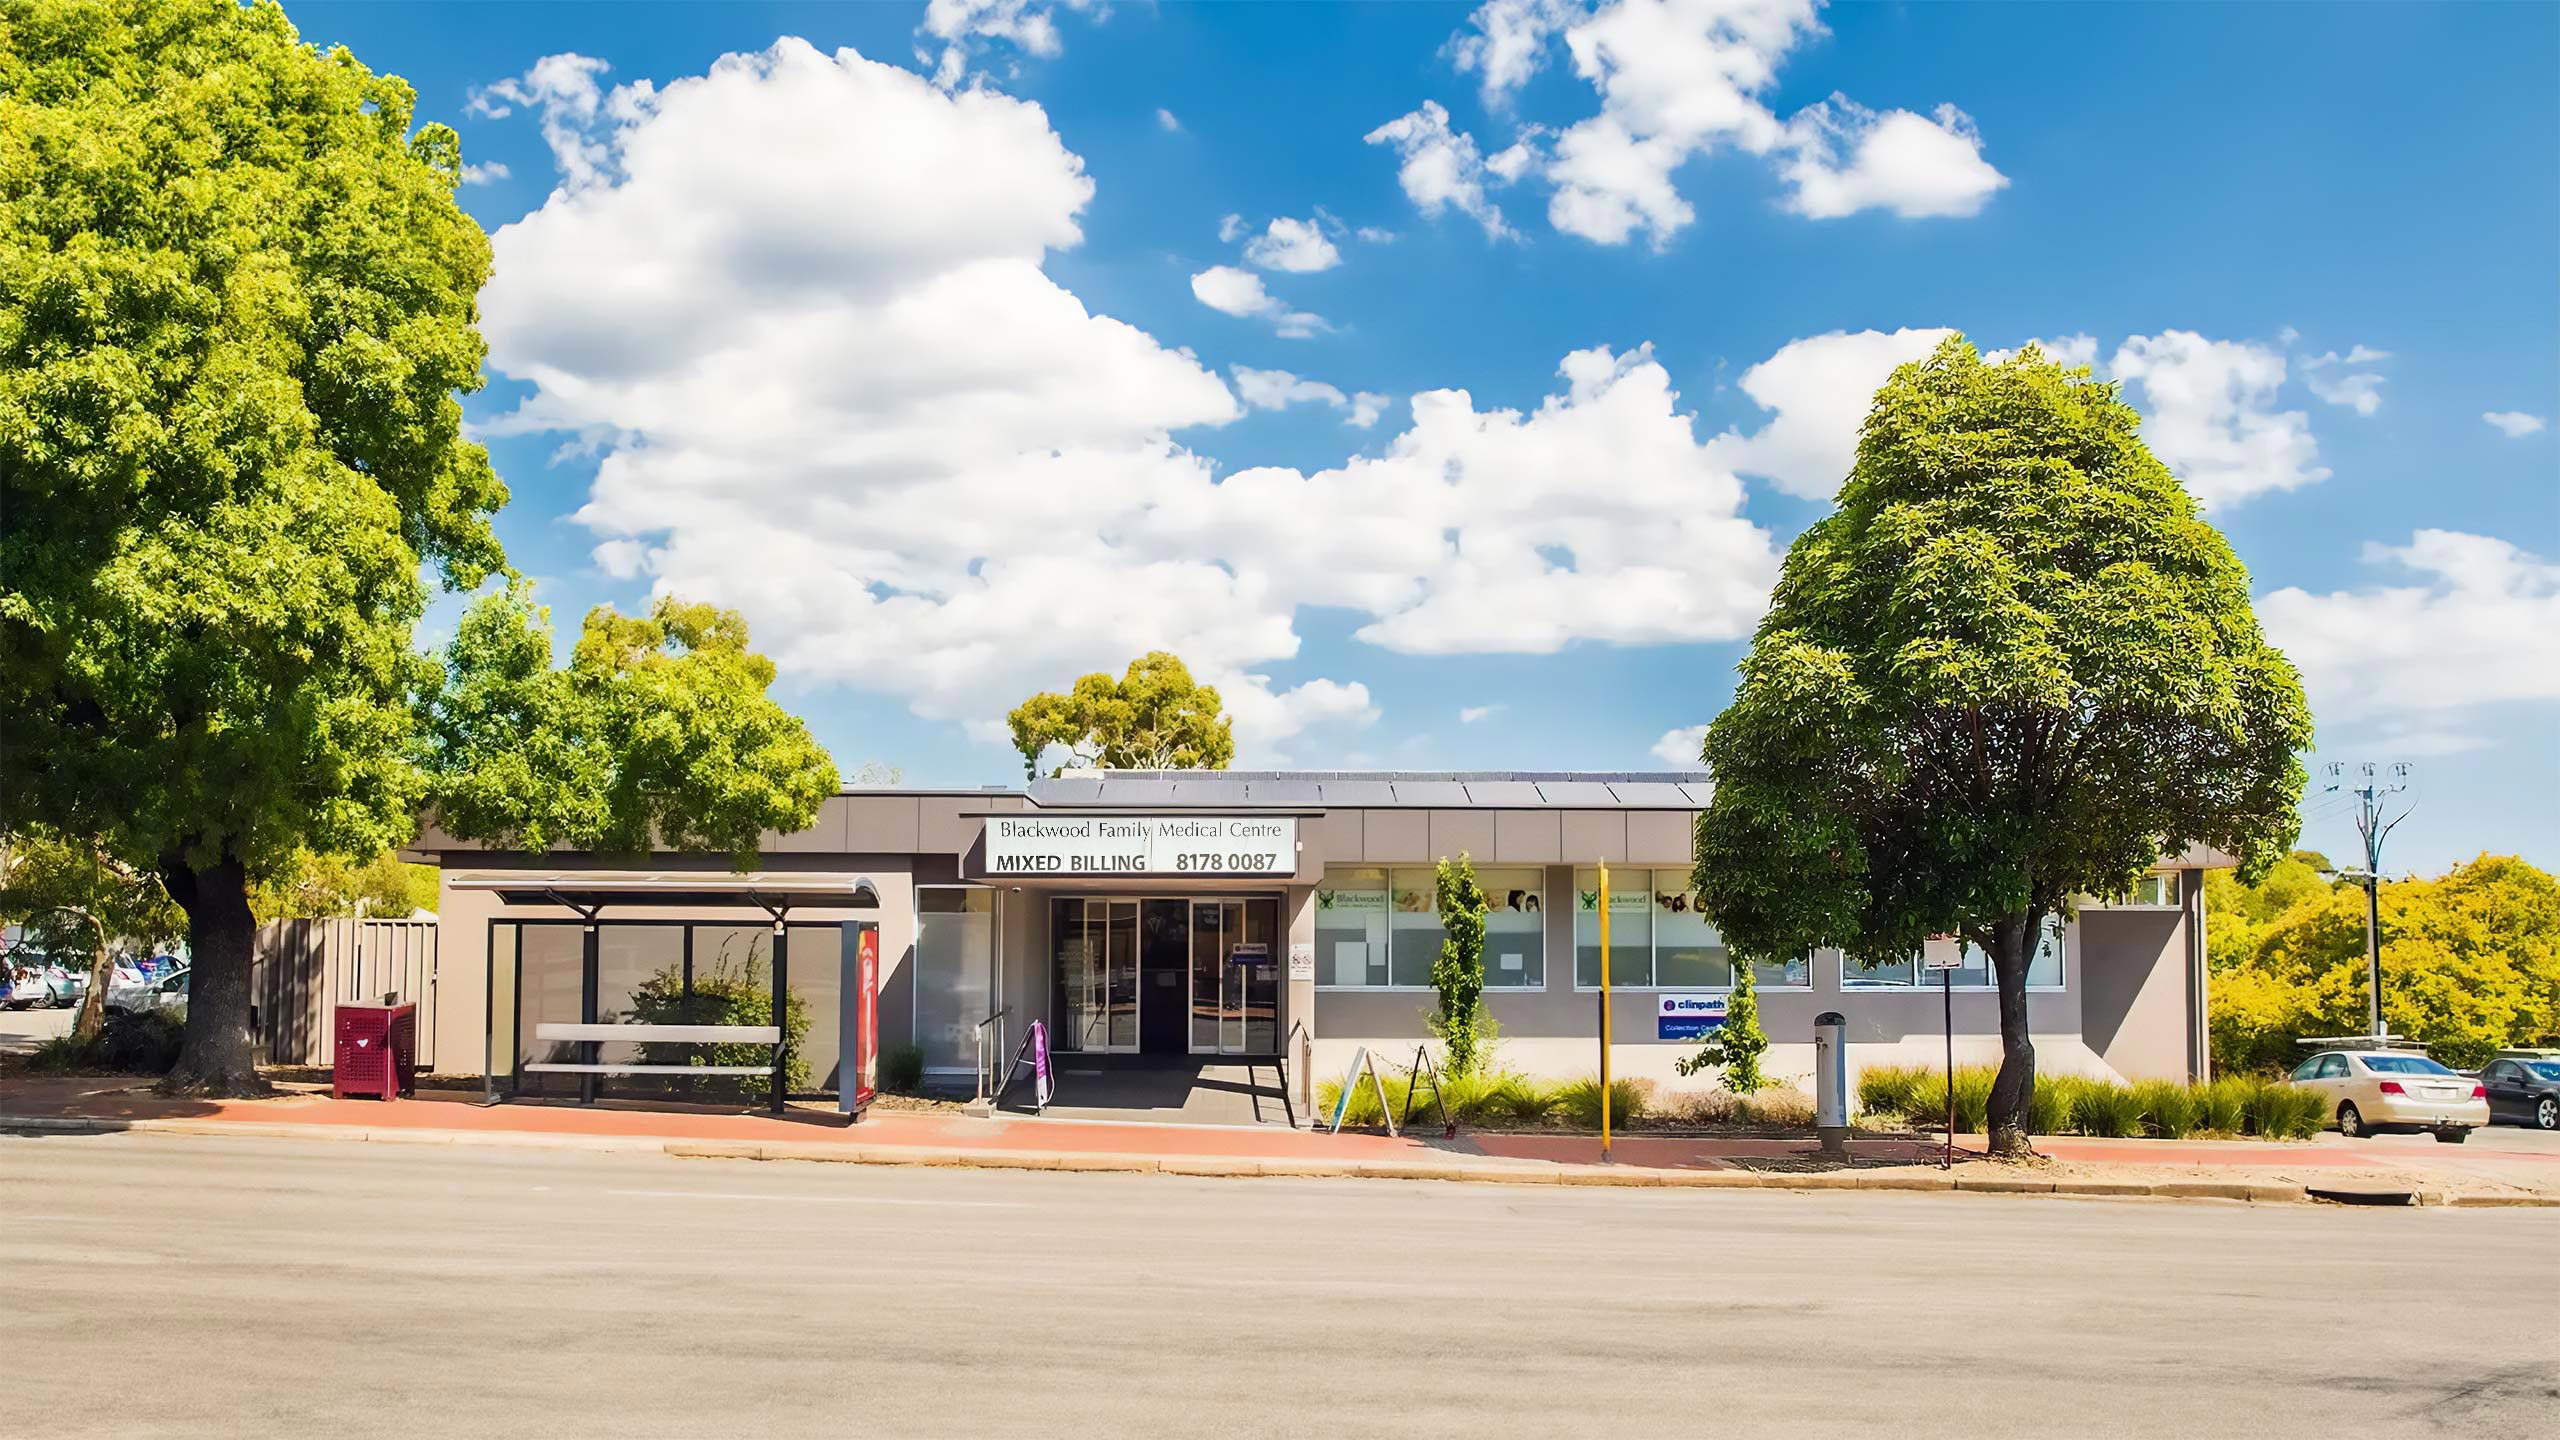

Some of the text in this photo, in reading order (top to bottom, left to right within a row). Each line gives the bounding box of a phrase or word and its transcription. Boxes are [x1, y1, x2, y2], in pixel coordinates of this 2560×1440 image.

[1001, 820, 1282, 842] Blackwood Family Medical Centre
[996, 853, 1277, 871] MIXED BILLING 8178 0087
[1336, 894, 1384, 903] Blackwood
[1609, 895, 1646, 903] ackwood
[1678, 1000, 1725, 1010] clinpath
